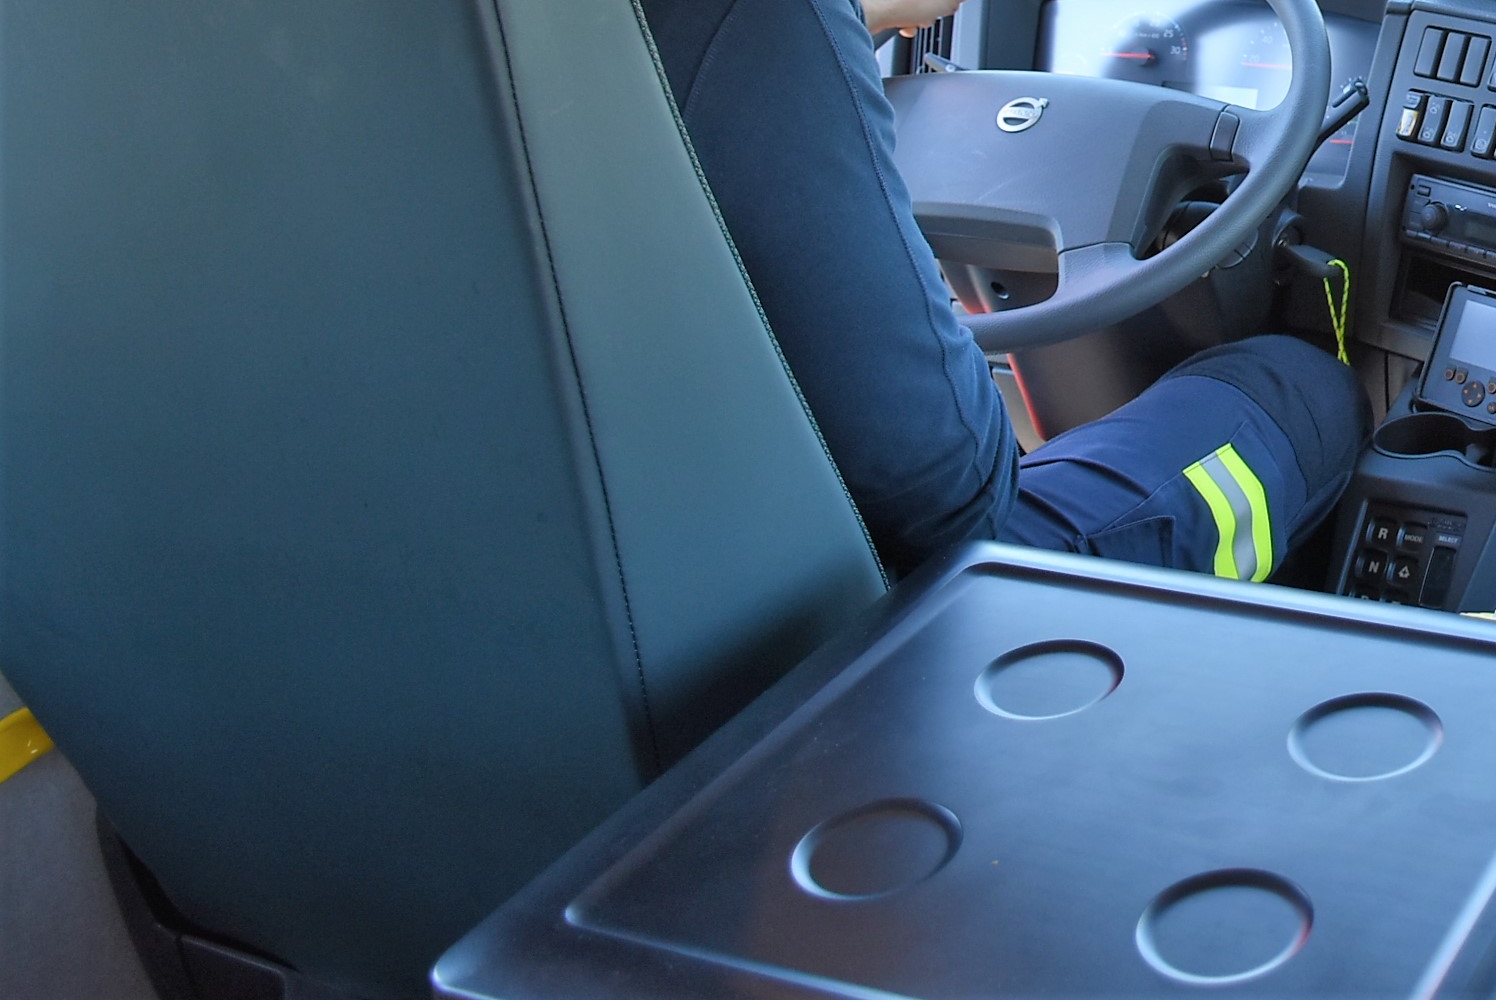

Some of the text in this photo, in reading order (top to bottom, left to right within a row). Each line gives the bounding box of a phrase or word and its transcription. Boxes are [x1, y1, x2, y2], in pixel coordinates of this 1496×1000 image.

[1170, 45, 1181, 55] 30
[1378, 527, 1389, 540] R
[1404, 533, 1424, 543] MODE
[1438, 535, 1459, 544] SELECT
[1368, 561, 1380, 574] N
